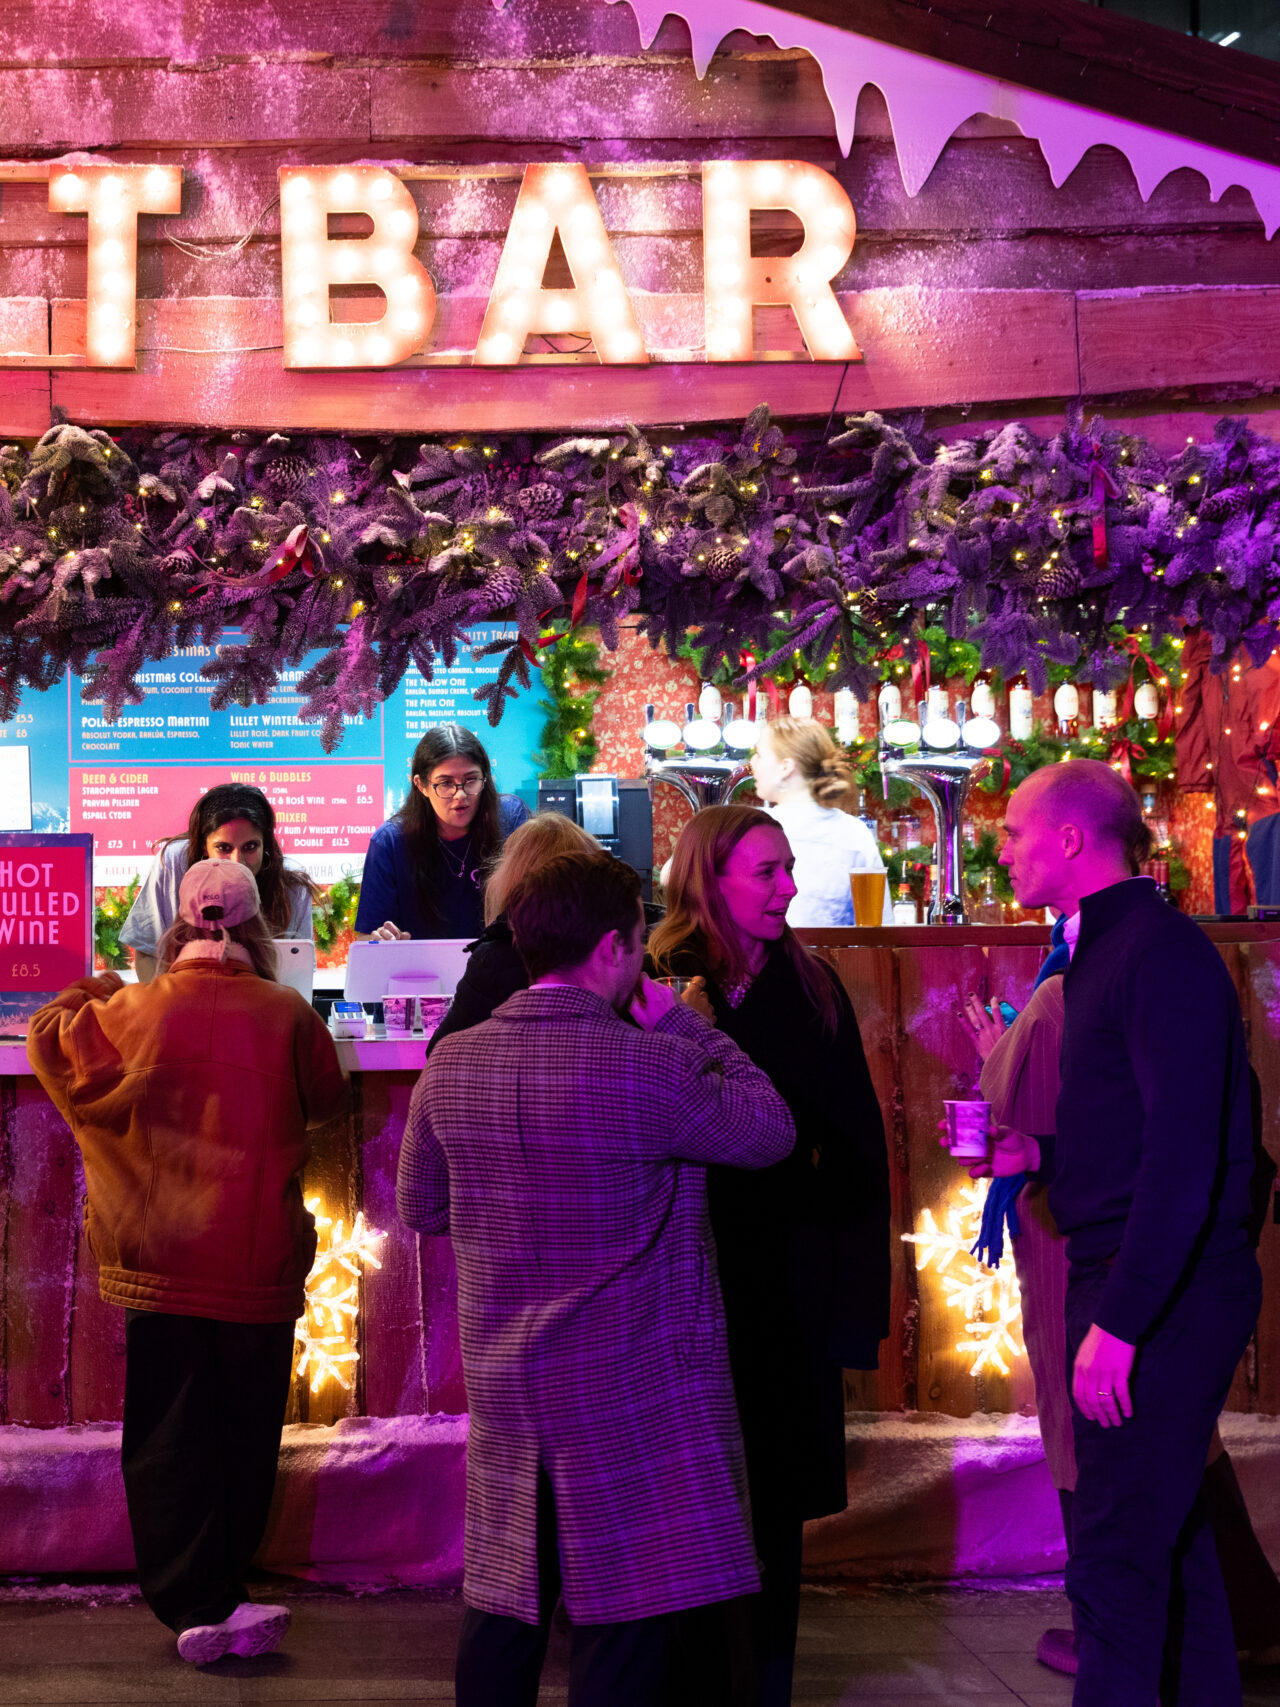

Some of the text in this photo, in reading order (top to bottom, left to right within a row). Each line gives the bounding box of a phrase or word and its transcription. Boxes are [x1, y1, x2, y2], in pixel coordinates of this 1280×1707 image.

[280, 159, 863, 369] BAR
[129, 672, 176, 683] RISTMAS
[405, 679, 418, 687] THE
[449, 678, 466, 686] ONE
[161, 686, 193, 694] COCONUT
[405, 699, 455, 707] THE PINK ONE
[16, 714, 34, 723] £5.5
[117, 717, 164, 727] ESPRESSO
[167, 716, 210, 727] MARTINI
[230, 715, 259, 726] LILLET
[406, 720, 419, 729] THE
[81, 731, 111, 739] ABSOLUT
[112, 731, 137, 739] VODKA,
[167, 731, 200, 739] ESPRESSO,
[230, 730, 249, 738] LILLET
[81, 742, 120, 751] CHOCOLATE
[230, 741, 250, 749] TONIC
[82, 773, 148, 784] BEER & CIDER
[230, 771, 312, 783] WINE & BUBBLES
[82, 786, 159, 795] STAROPRAMEN LAGER
[111, 798, 140, 807] PILSNER
[285, 795, 304, 805] ROSÉ
[306, 796, 325, 805] WINE
[82, 810, 132, 820] ASPALL CYDER
[276, 811, 307, 822] MIXER
[284, 826, 301, 834] RUM
[309, 825, 339, 834] WHISKEY
[346, 825, 376, 834] TEQUILA
[108, 840, 123, 849] £7.5
[294, 838, 349, 847] DOUBLE £12.5
[11, 963, 41, 977] £8.5
